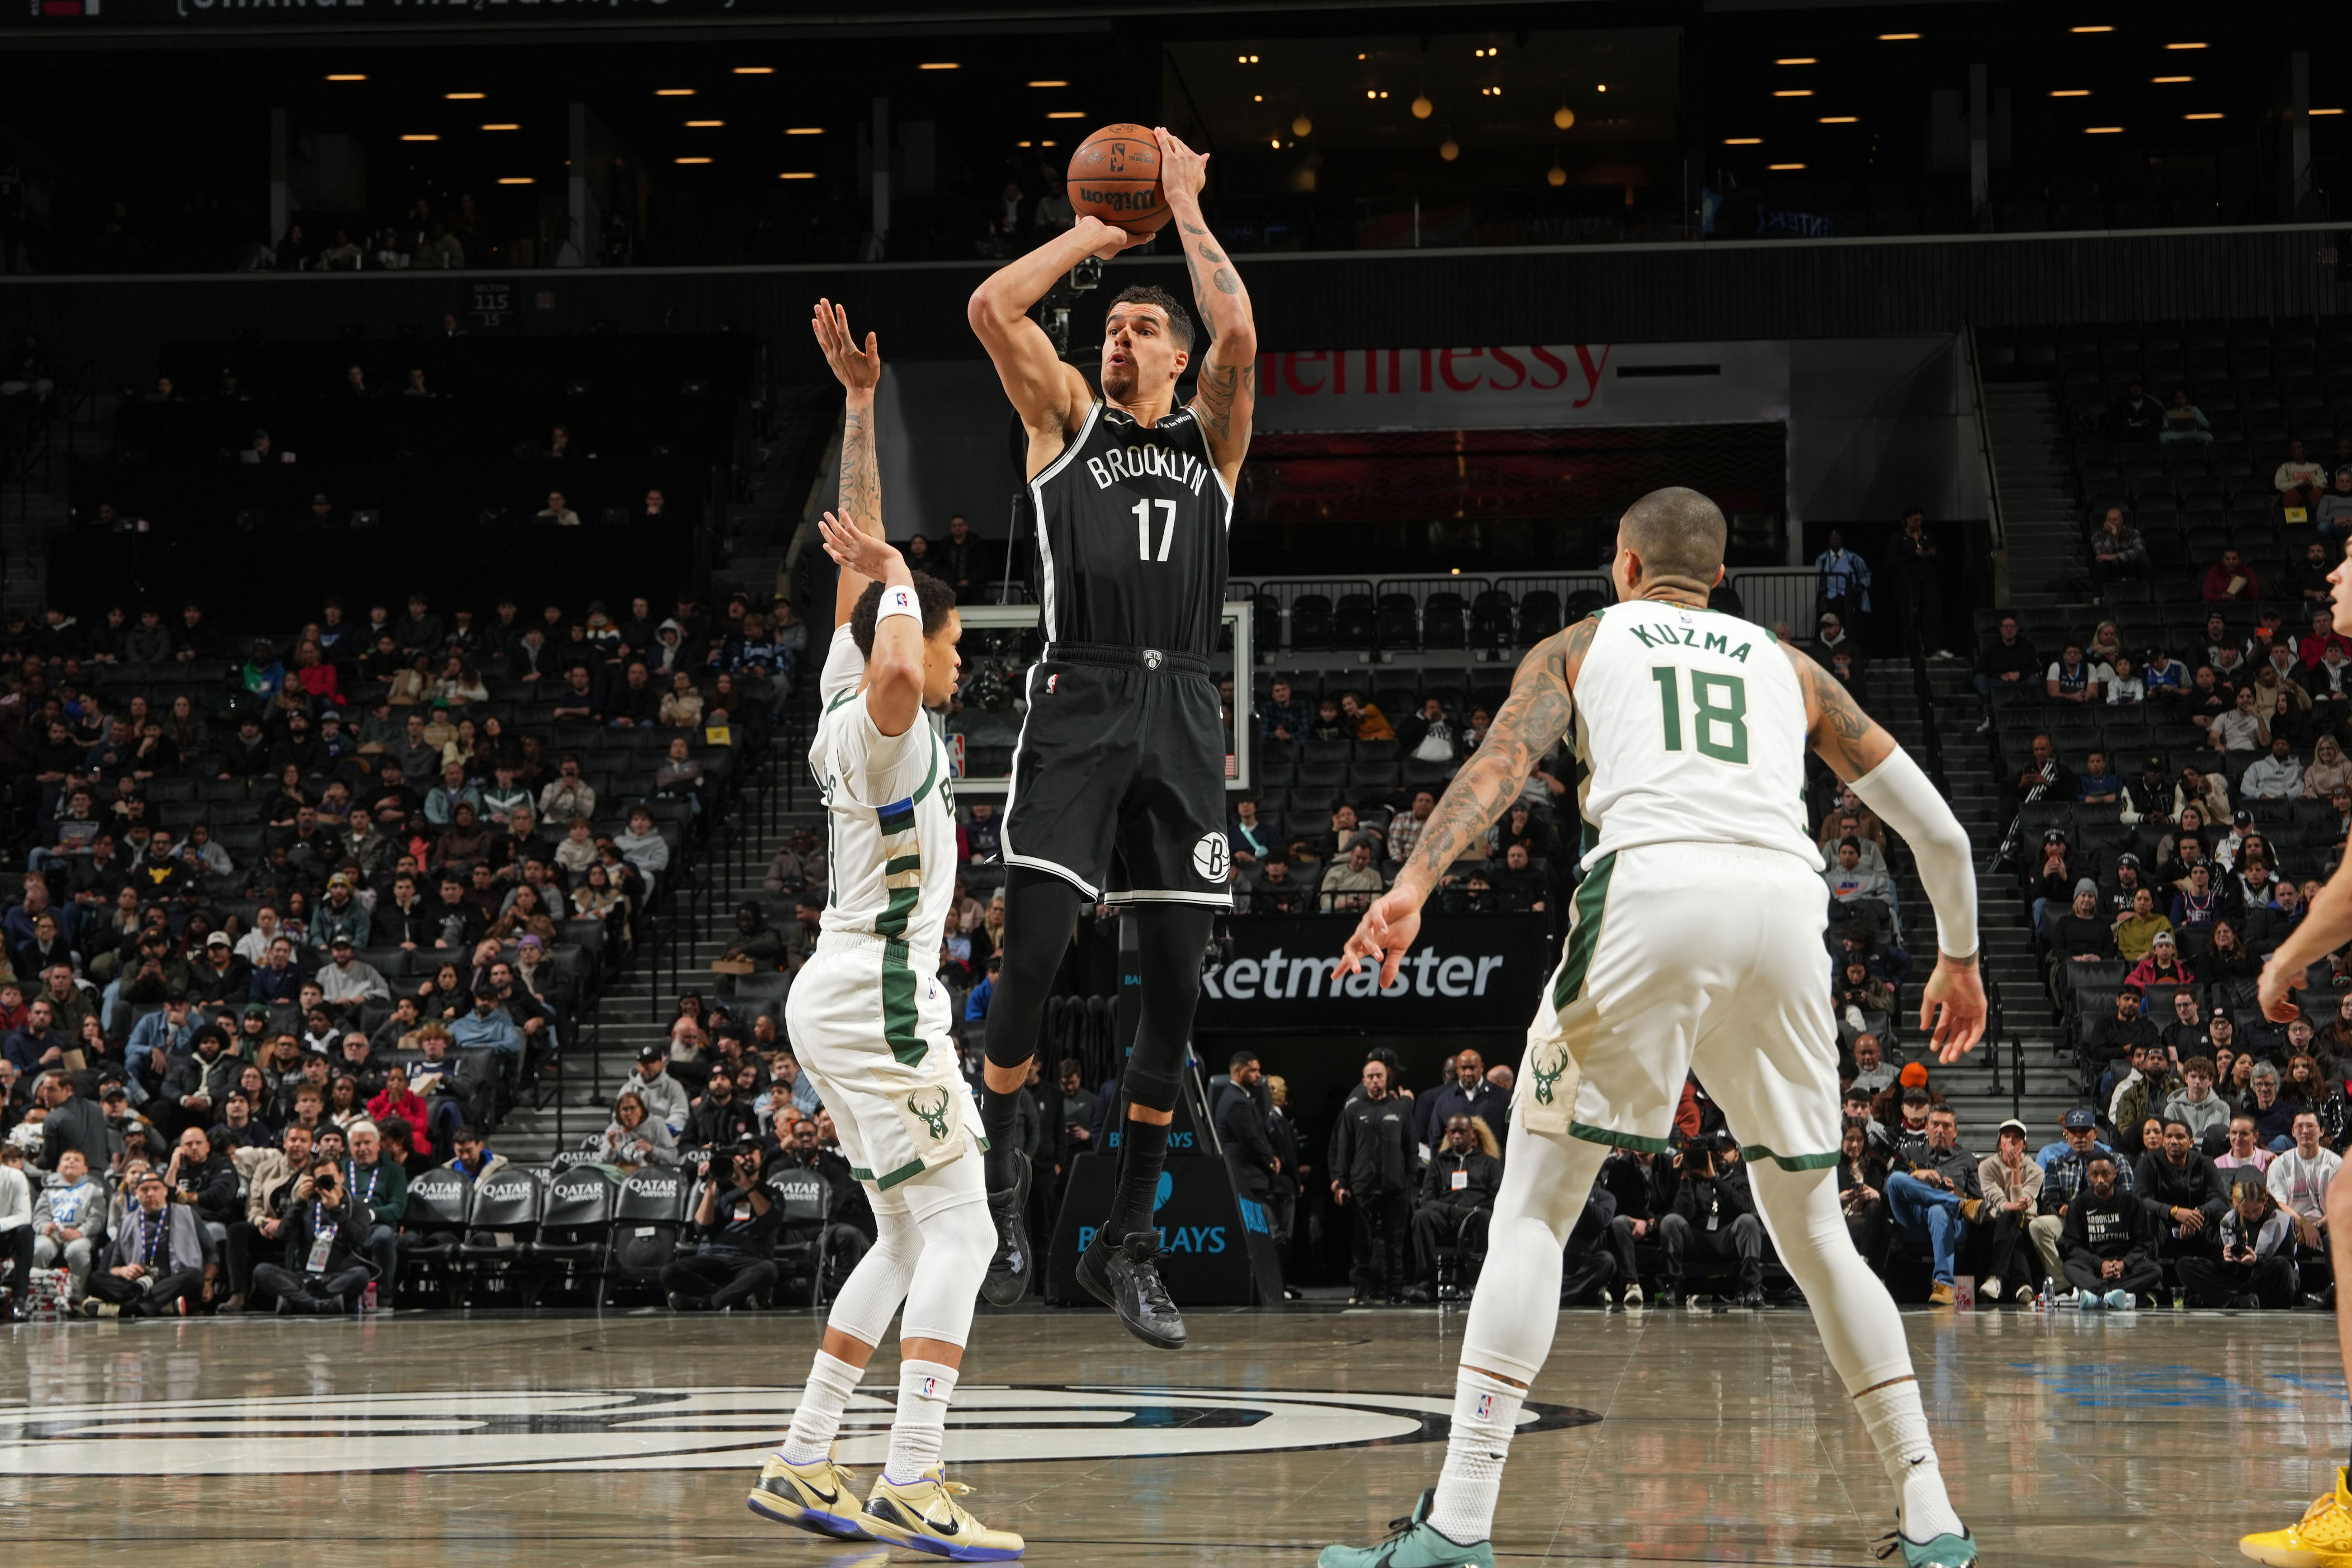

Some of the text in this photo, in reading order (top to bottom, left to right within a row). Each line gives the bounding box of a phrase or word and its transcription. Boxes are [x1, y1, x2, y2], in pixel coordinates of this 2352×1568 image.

[1080, 186, 1157, 211] Wilson
[475, 294, 509, 310] 115
[483, 314, 500, 327] 15
[1257, 343, 1612, 409] ennessy
[1087, 443, 1207, 497] BROOKLYN
[1131, 498, 1177, 562] 17
[1629, 624, 1751, 663] KUZMA
[1145, 651, 1160, 660] NETS
[1649, 663, 1751, 767] 18
[1209, 838, 1223, 876] B
[2186, 908, 2213, 922] NETS
[414, 1181, 462, 1196] QATAR
[483, 1182, 531, 1197] QATAR
[554, 1182, 604, 1198] QATAR
[629, 1178, 677, 1193] QATAR
[494, 1193, 531, 1201] AIRWAYS
[566, 1193, 604, 1202] AIRWAYS
[2087, 1213, 2120, 1224] BROOKLYN
[2089, 1231, 2129, 1243] BASKETBALL
